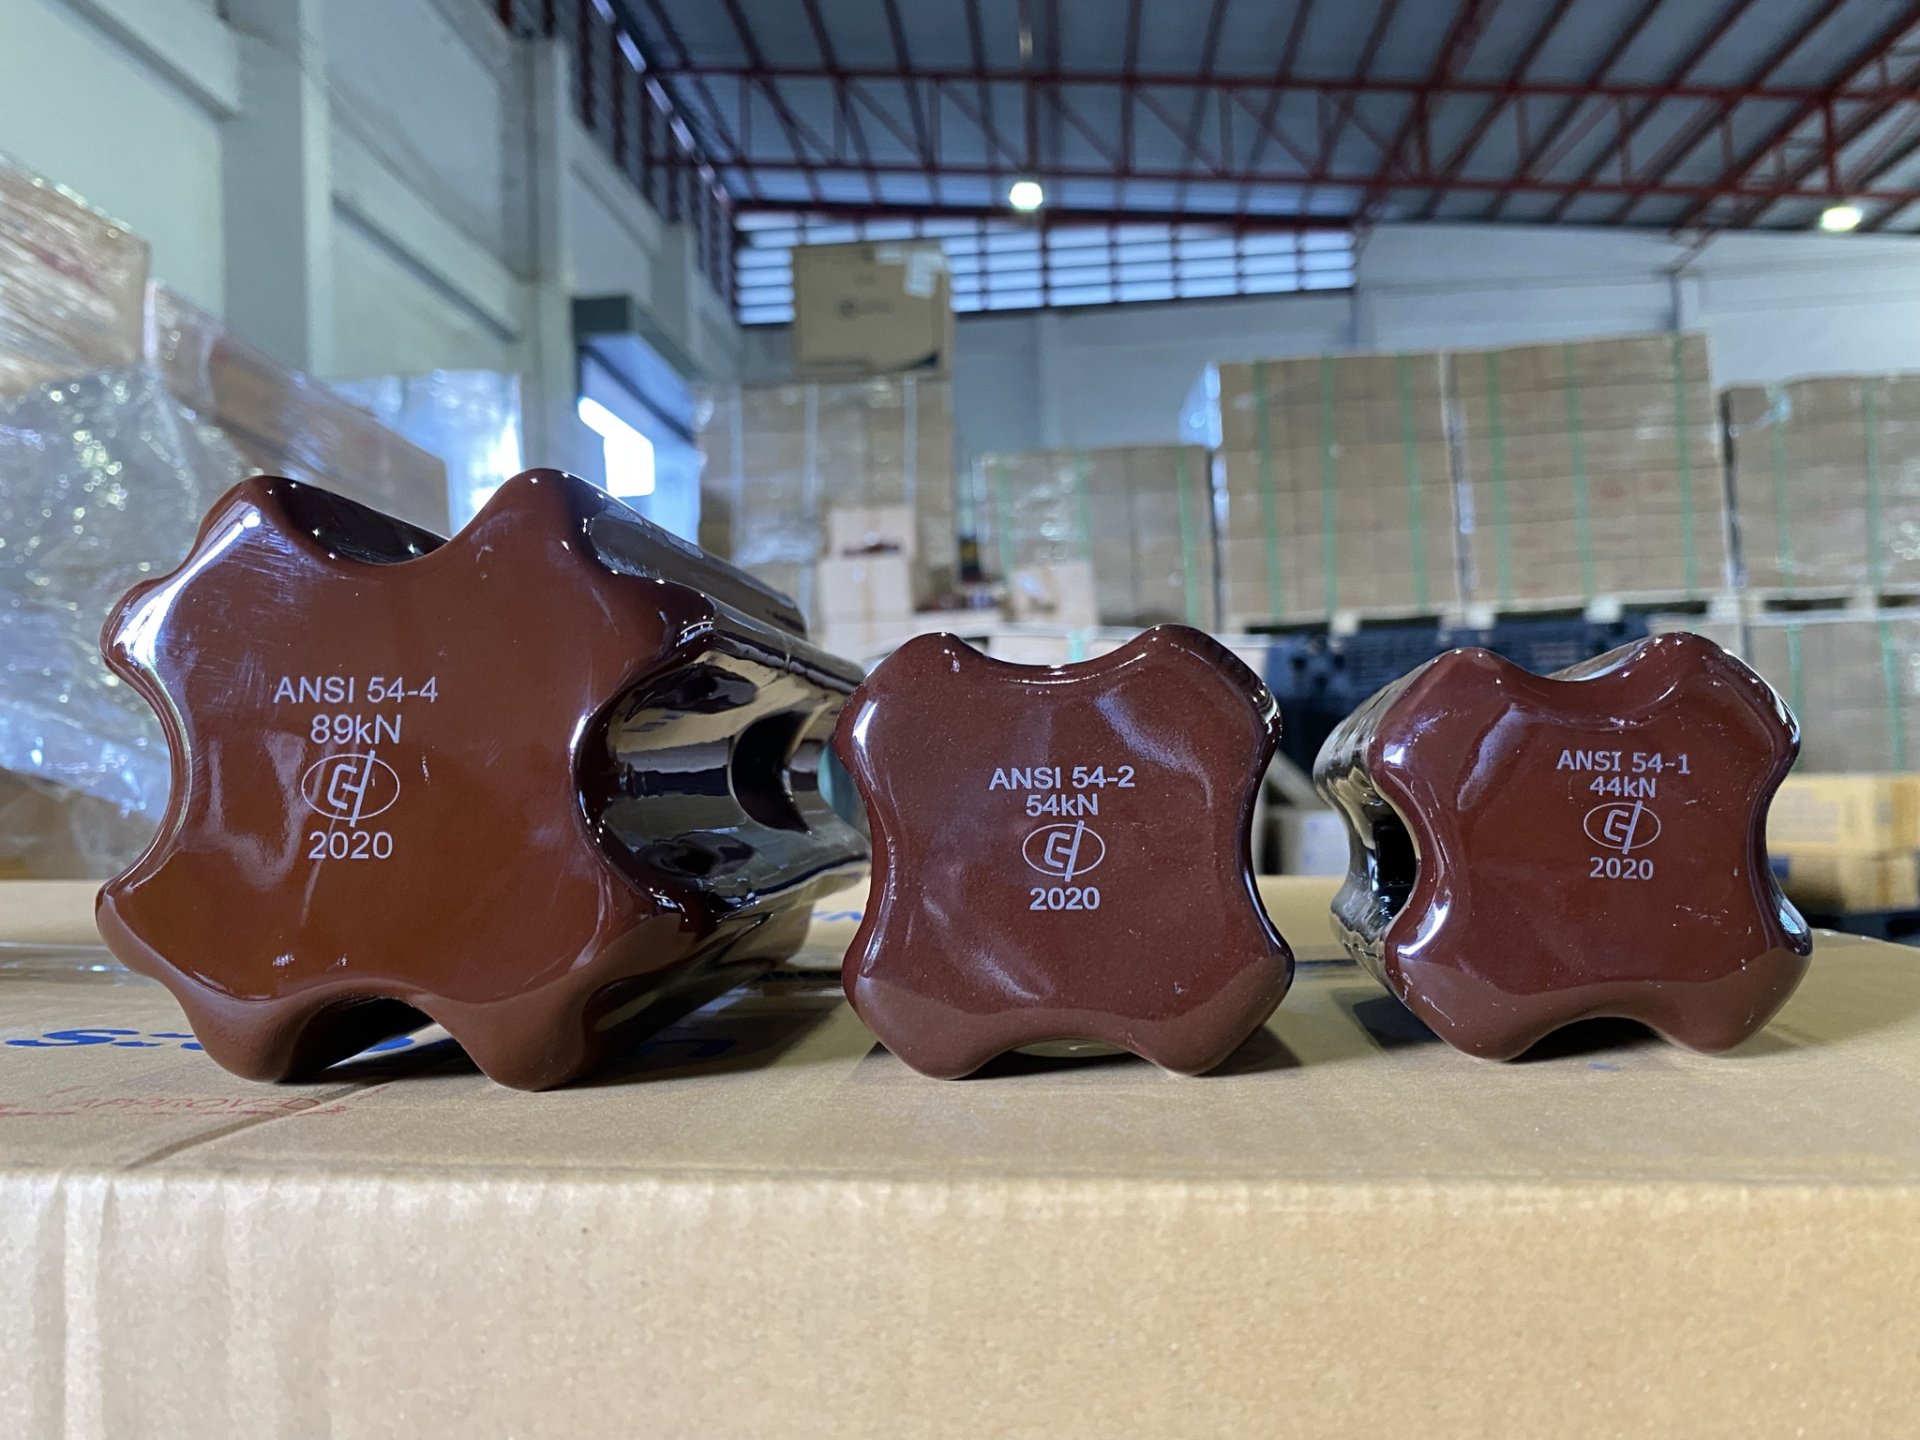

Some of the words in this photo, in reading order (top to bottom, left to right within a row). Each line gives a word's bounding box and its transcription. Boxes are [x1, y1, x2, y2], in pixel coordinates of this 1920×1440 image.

[273, 676, 355, 704] ANSI
[367, 676, 439, 703] 54-4
[310, 714, 402, 744] 89kN
[1556, 749, 1622, 772] ANSI
[1631, 752, 1690, 775] 54-1
[989, 766, 1061, 790] ANSI
[1072, 765, 1135, 788] 54-2
[1589, 775, 1656, 798] 44kN
[1025, 793, 1099, 817] 54kN
[308, 831, 393, 859] 2020
[1589, 857, 1654, 880] 2020
[1029, 887, 1101, 911] 2020
